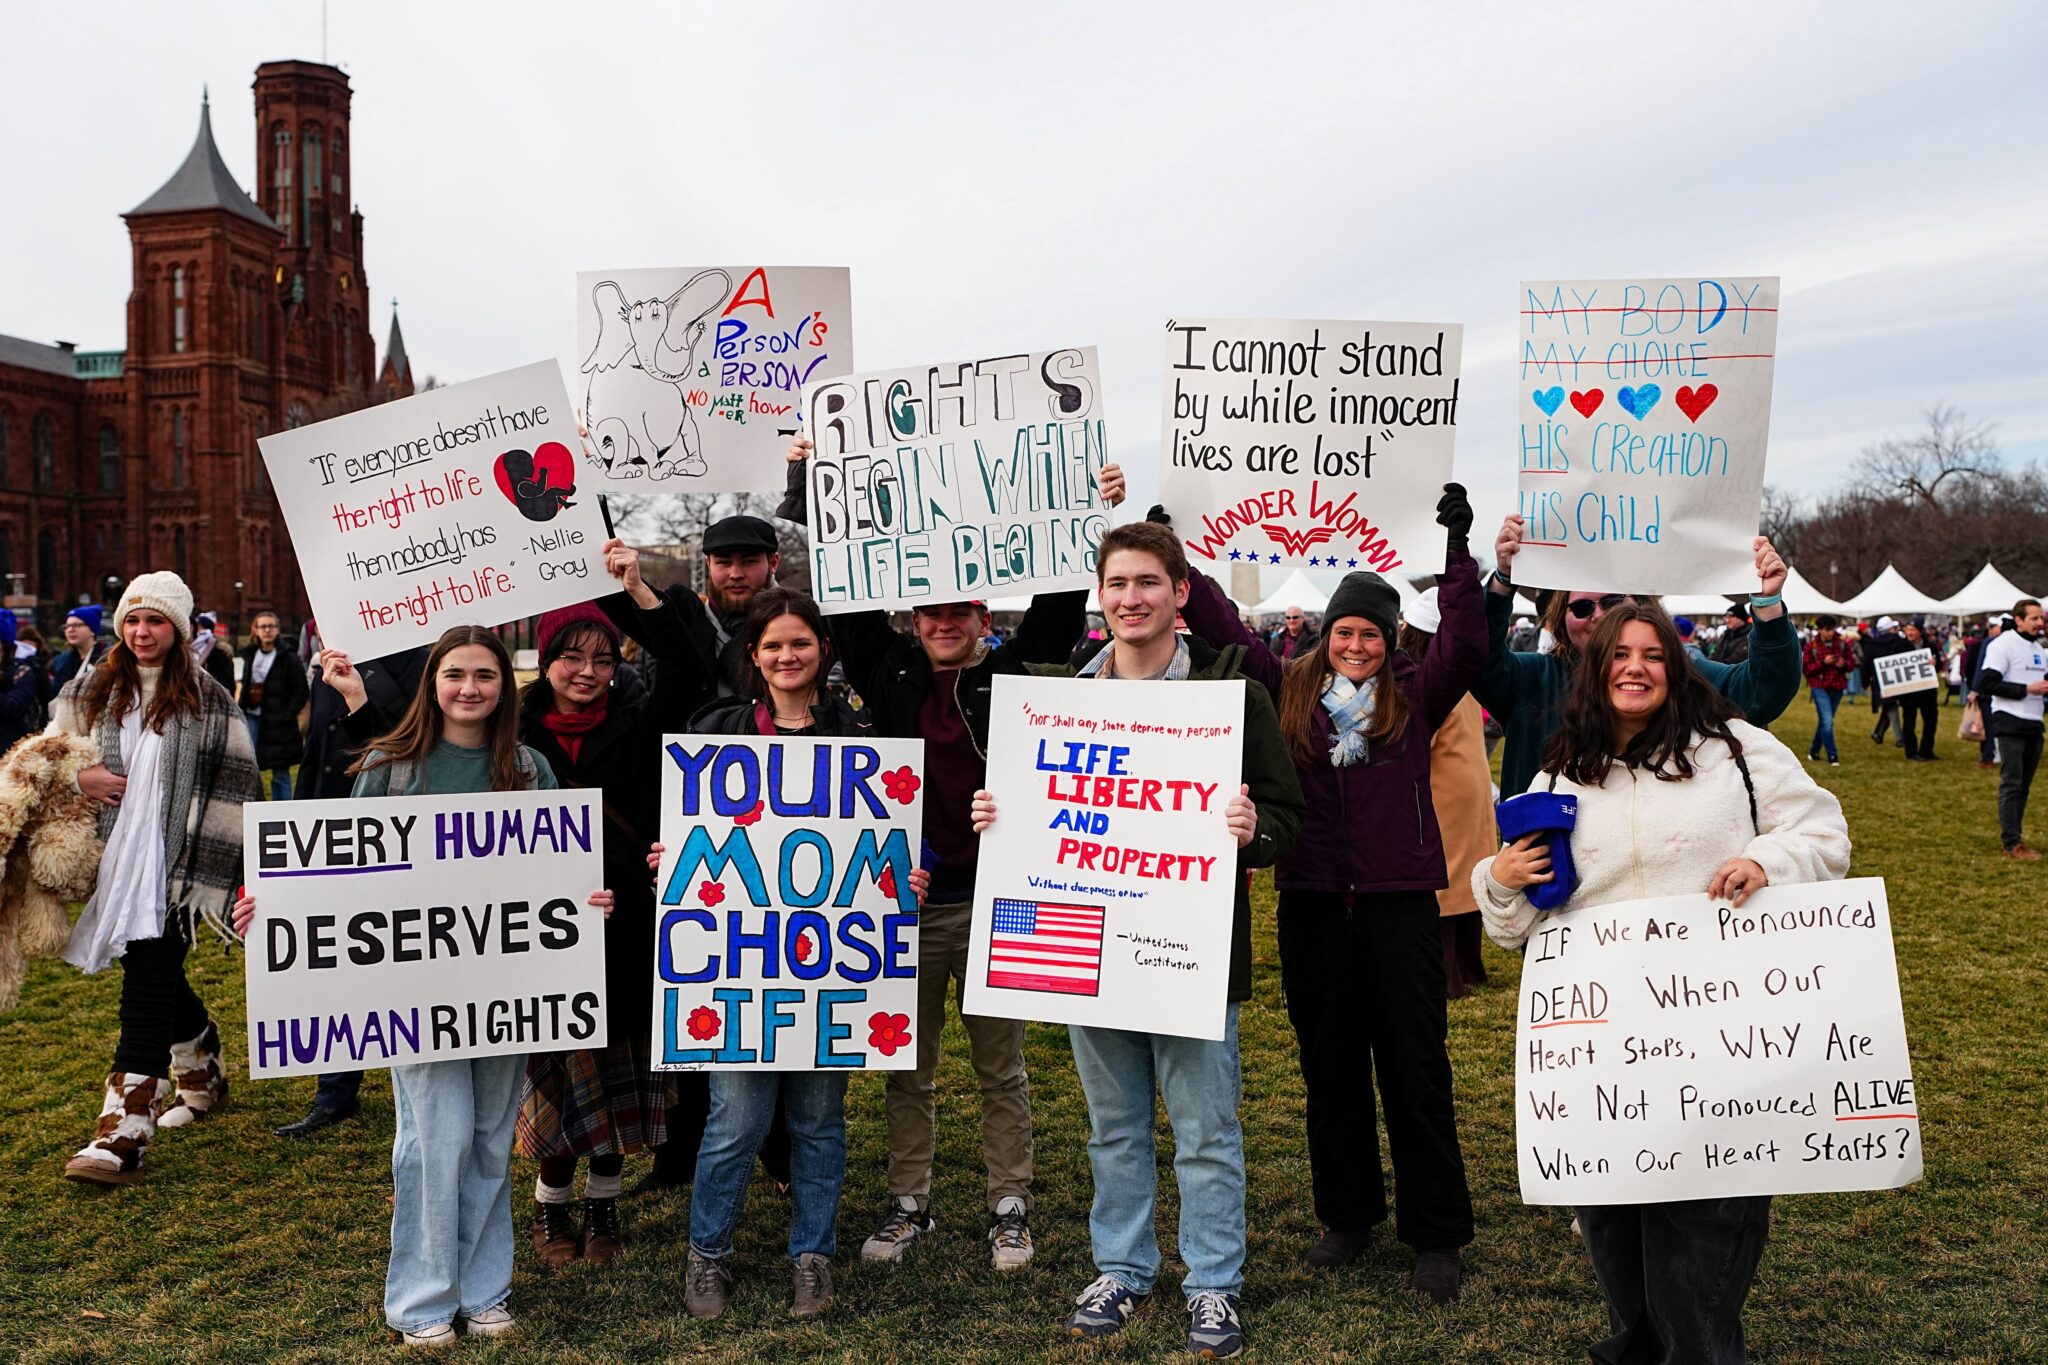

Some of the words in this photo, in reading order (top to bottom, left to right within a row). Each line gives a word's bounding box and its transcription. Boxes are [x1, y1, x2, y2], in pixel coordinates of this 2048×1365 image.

[720, 267, 775, 319] A
[1528, 286, 1598, 335] MY
[1621, 280, 1760, 337] BODY
[1212, 329, 1326, 378] cannot
[1339, 331, 1444, 378] stand
[1522, 340, 1586, 382] MY
[1607, 340, 1708, 380] CHOICE
[686, 389, 708, 407] NO
[749, 391, 793, 417] how
[811, 349, 1093, 460] RIGHTS
[1174, 378, 1209, 436] by
[1222, 379, 1316, 424] while
[1330, 378, 1459, 426] innocent
[345, 438, 431, 478] everyone
[432, 408, 498, 452] doesn't
[497, 404, 550, 434] have
[1172, 429, 1233, 471] lives
[1246, 444, 1299, 474] are
[418, 479, 446, 507] to
[444, 469, 483, 500] life
[813, 443, 963, 543] BEGIN
[974, 419, 1110, 515] WHEN
[390, 527, 464, 565] nobody
[456, 522, 497, 549] has
[1185, 489, 1298, 561] WONDER
[1309, 480, 1403, 573] WOMAN
[539, 558, 589, 581] Gray
[817, 534, 930, 602] LIFE
[952, 515, 1110, 592] BEGINS
[446, 577, 475, 604] to
[1879, 657, 1908, 669] LEAD
[1909, 652, 1928, 663] ON
[1881, 663, 1933, 686] LIFE
[1077, 718, 1098, 733] any
[1130, 721, 1165, 735] deprive
[1166, 726, 1183, 738] any
[1186, 726, 1221, 738] person
[1223, 725, 1233, 736] of
[665, 741, 891, 820] YOUR
[258, 815, 417, 869] EVERY
[434, 805, 592, 860] HUMAN
[1049, 808, 1110, 836] AND
[660, 825, 920, 913] MOM
[1056, 837, 1218, 882] PROPERTY
[1028, 875, 1067, 891] Without
[1070, 882, 1089, 893] due
[1089, 886, 1116, 897] process
[266, 898, 579, 972] DESERVES
[658, 909, 919, 983] CHOSE
[1161, 937, 1189, 951] States
[1594, 919, 1633, 946] We
[1644, 918, 1689, 942] Are
[1718, 900, 1876, 941] Pronounced
[1134, 949, 1199, 971] Constitution
[1531, 981, 1608, 1023] DEAD
[1645, 975, 1739, 1009] When
[1764, 965, 1826, 996] Our
[257, 1007, 420, 1068] HUMAN
[430, 992, 600, 1051] RIGHTS
[661, 987, 868, 1069] LIFE
[1530, 1039, 1595, 1073] Heart
[1826, 1022, 1874, 1061] Are
[1530, 1090, 1568, 1121] We
[1597, 1084, 1650, 1121] Not
[1680, 1084, 1816, 1121] Pronouced
[1834, 1079, 1914, 1115] ALIVE
[1532, 1146, 1609, 1181] When
[1636, 1148, 1682, 1174] Our
[1705, 1139, 1780, 1169] Heart
[1802, 1127, 1911, 1162] Starts?
